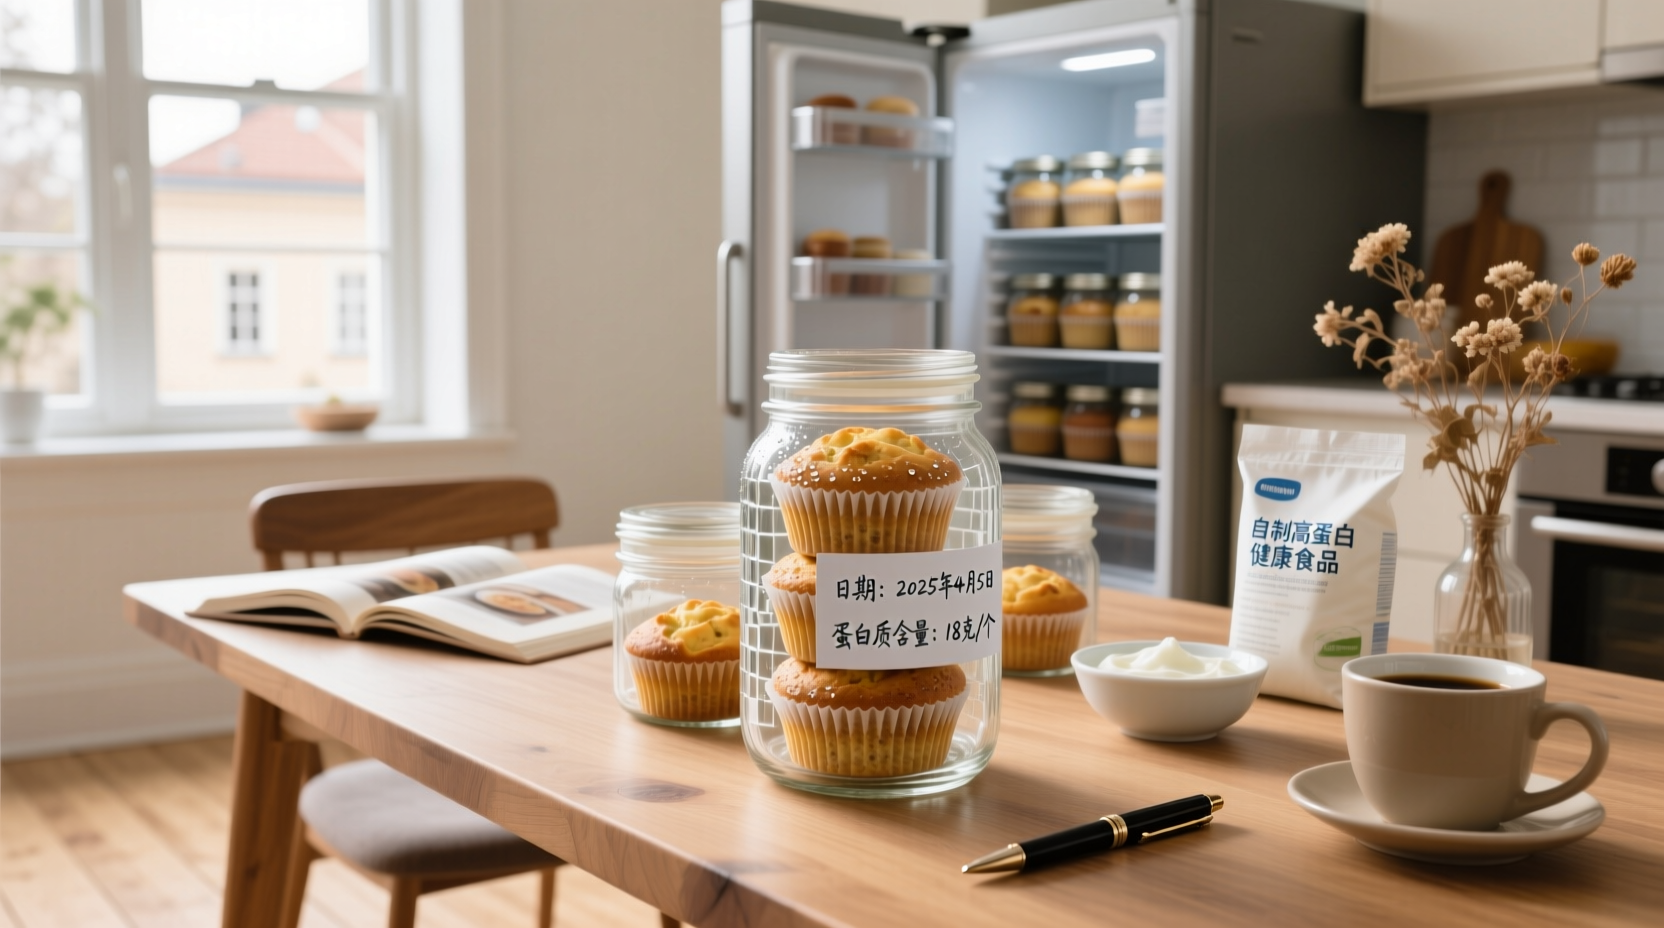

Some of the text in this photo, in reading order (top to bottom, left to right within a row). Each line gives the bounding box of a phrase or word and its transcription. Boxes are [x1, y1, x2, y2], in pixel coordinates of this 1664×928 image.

[1252, 516, 1354, 549] 自制高蛋白
[1250, 542, 1339, 574] 健康食品
